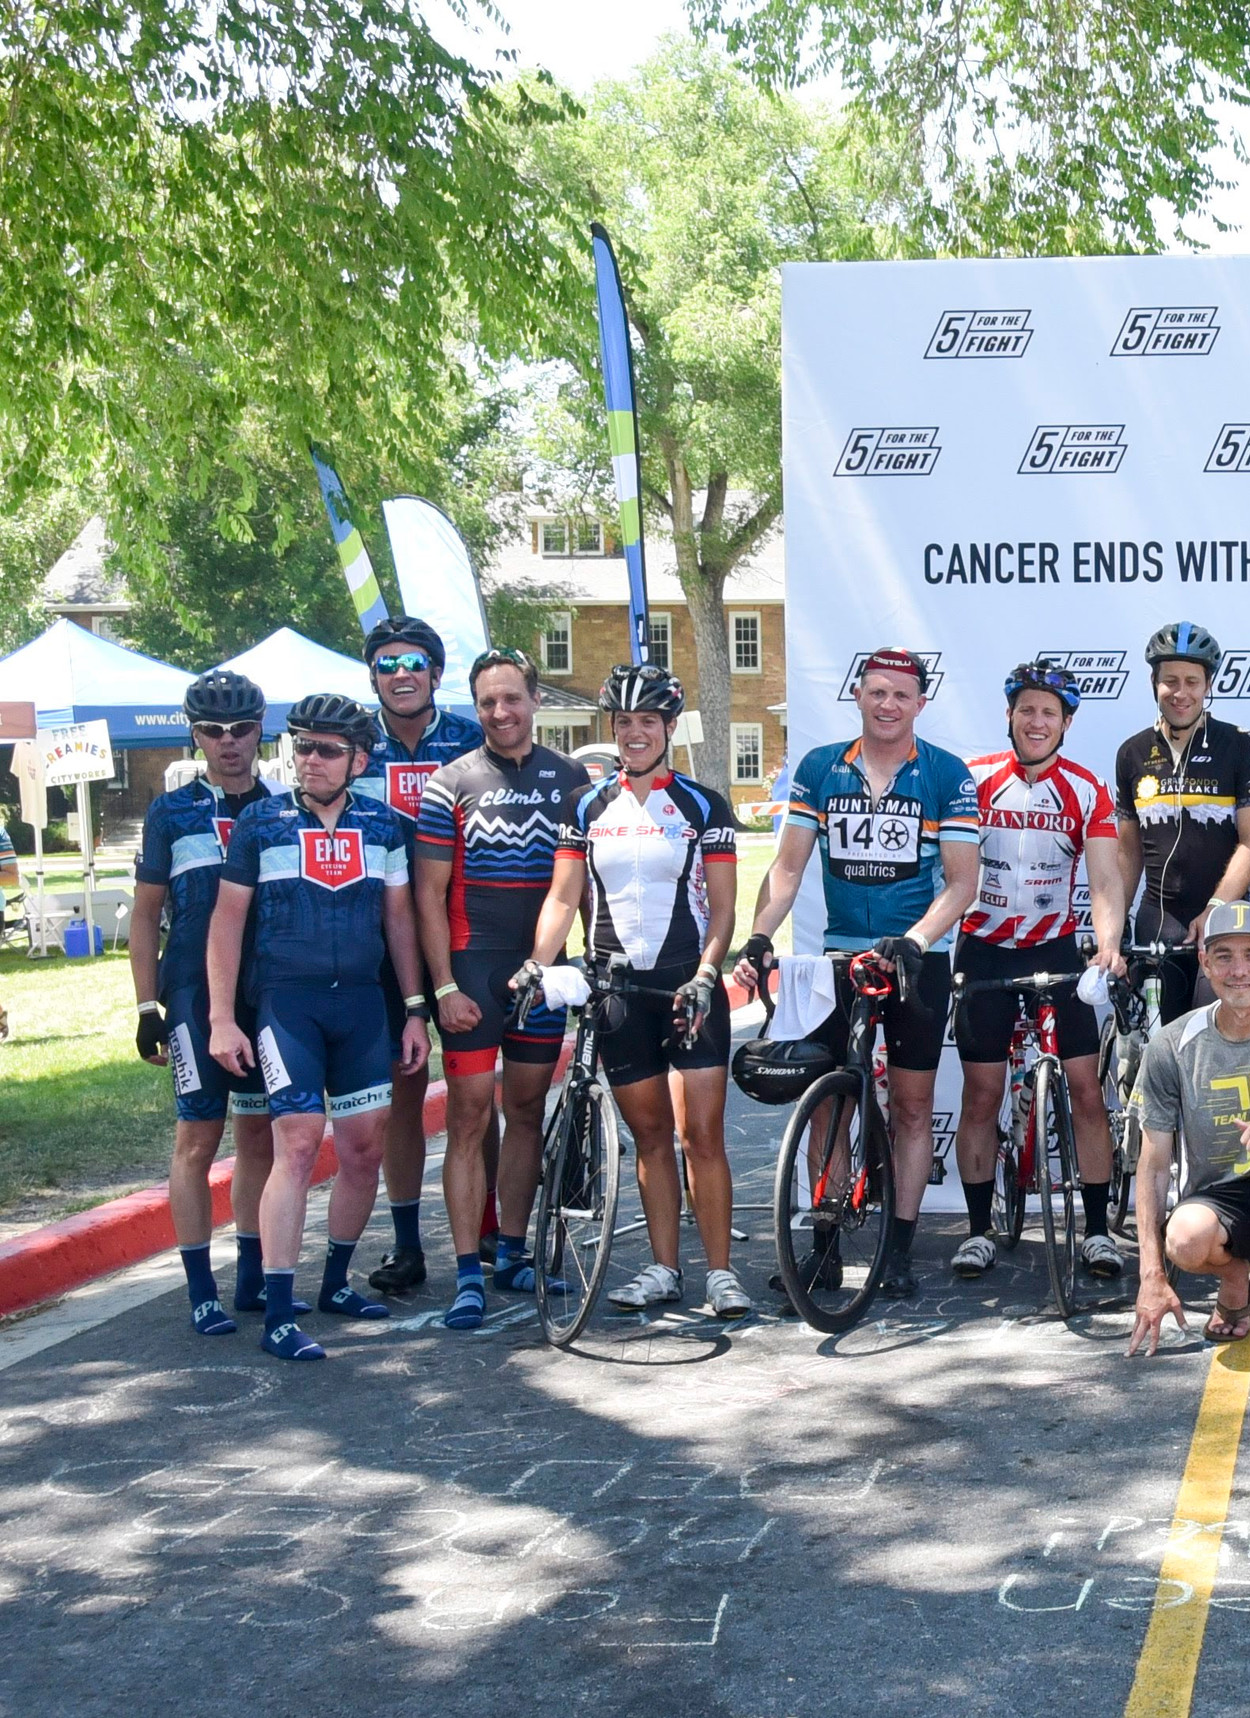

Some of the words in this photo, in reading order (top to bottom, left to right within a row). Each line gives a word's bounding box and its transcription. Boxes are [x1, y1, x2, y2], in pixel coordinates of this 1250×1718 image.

[977, 317, 999, 326] FOR
[1001, 317, 1021, 326] THE
[1163, 314, 1185, 323] FOR
[1187, 314, 1207, 323] THE
[936, 317, 966, 353] 5
[1122, 314, 1152, 350] 5
[966, 336, 1024, 353] FIGHT
[1152, 333, 1210, 350] FIGHT
[886, 434, 908, 443] FOR
[910, 434, 930, 443] THE
[1070, 432, 1092, 441] FOR
[1094, 432, 1114, 441] THE
[845, 434, 875, 470] 5
[1029, 432, 1059, 468] 5
[1215, 431, 1245, 467] 5
[875, 453, 933, 470] FIGHT
[1059, 451, 1117, 468] FIGHT
[924, 540, 1061, 585] CANCER
[1073, 540, 1164, 585] ENDS
[1072, 657, 1094, 667] FOR
[1096, 657, 1117, 667] THE
[1217, 658, 1247, 694] 5
[1077, 677, 1120, 694] GHT
[46, 741, 107, 768] REAMIES
[550, 789, 561, 804] 6
[1160, 785, 1184, 794] SALT
[1189, 785, 1219, 794] LAKE
[827, 797, 922, 817] HUNTSMAN
[978, 807, 1076, 833] STANFORD
[589, 826, 629, 838] BIKE
[314, 838, 351, 862] EPIC
[844, 861, 896, 881] qualtrics
[1024, 876, 1063, 886] SRAM
[985, 892, 1007, 907] CLIF
[581, 1028, 595, 1066] BMC
[1212, 1111, 1247, 1127] TEAM
[270, 1323, 301, 1345] EPI
